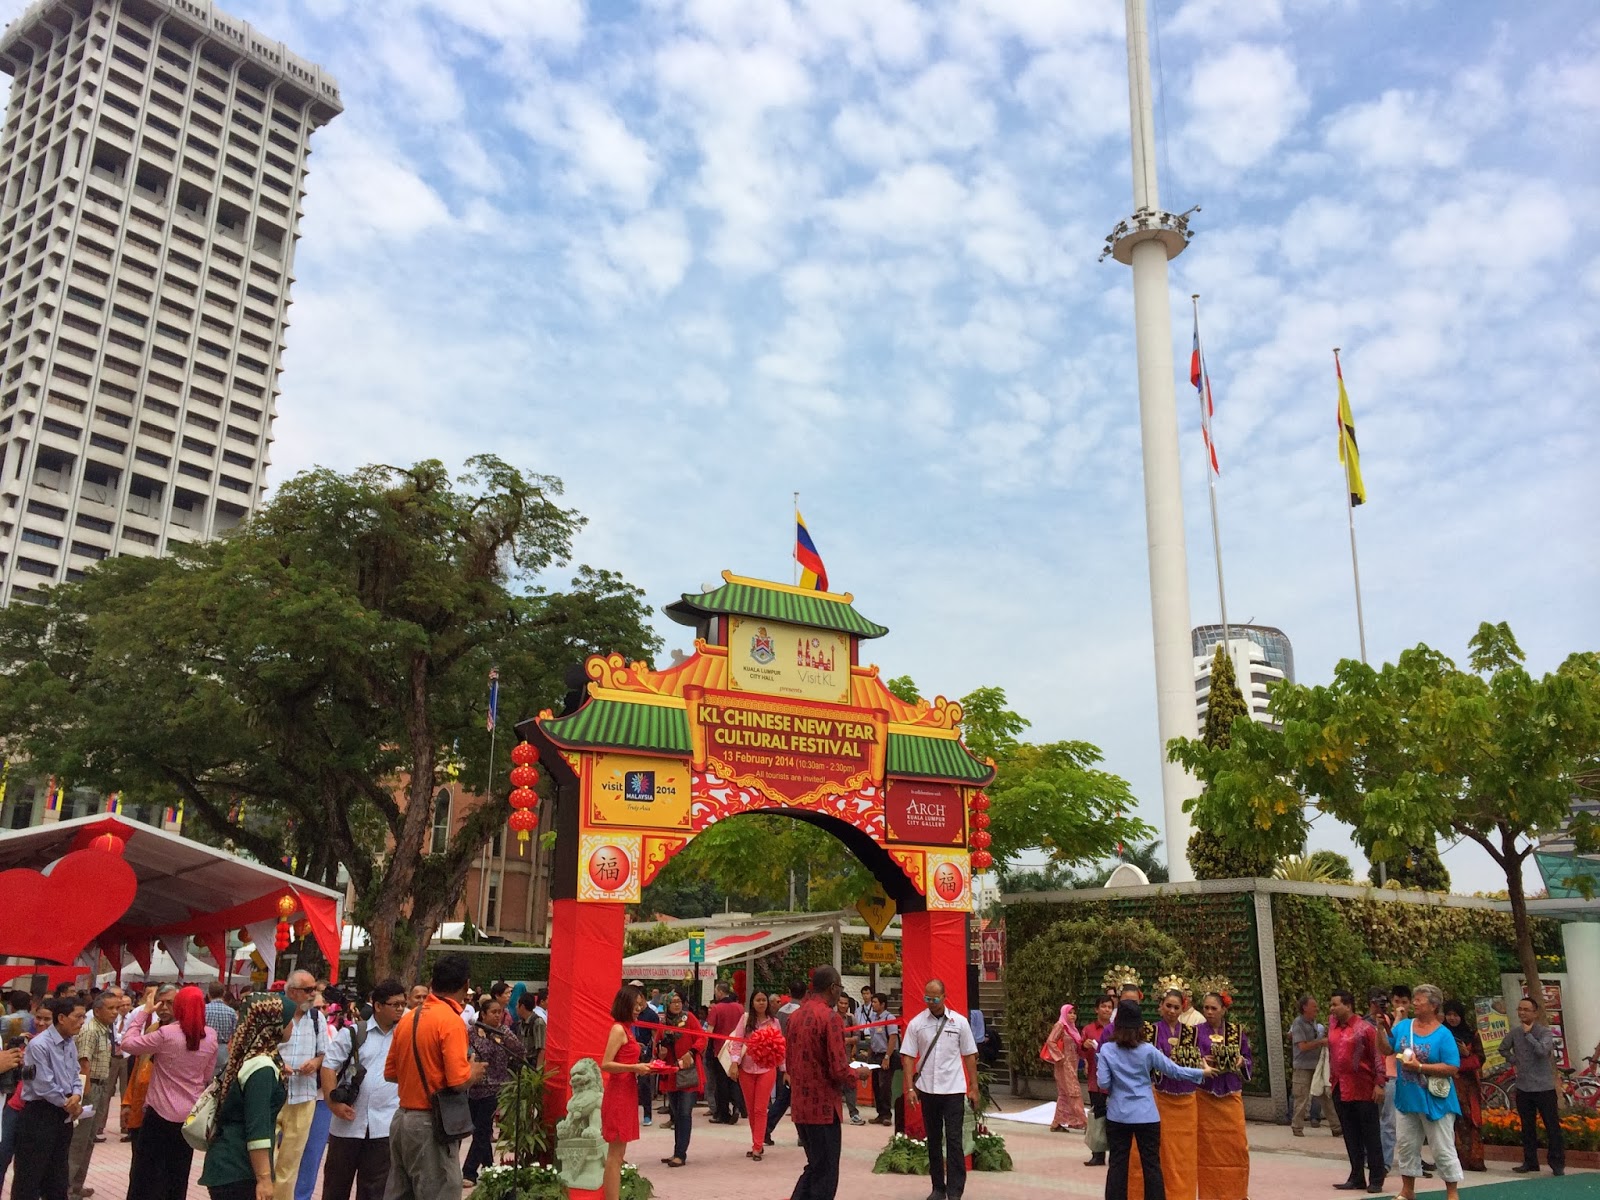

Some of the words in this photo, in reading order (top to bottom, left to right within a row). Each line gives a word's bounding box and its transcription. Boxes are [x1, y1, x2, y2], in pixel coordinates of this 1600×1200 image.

[779, 686, 803, 694] presents
[699, 706, 721, 724] KL
[723, 709, 791, 732] CHINESE
[794, 717, 833, 736] NEW
[834, 721, 874, 741] YEAR
[714, 728, 789, 750] CULTURAL
[791, 737, 861, 758] FESTIVAL
[723, 750, 733, 762] 13
[735, 751, 773, 768] February
[775, 755, 795, 768] 2014
[795, 759, 825, 771] (10:30am
[829, 763, 856, 775] 2:30pm)
[755, 770, 765, 778] All
[765, 771, 790, 781] tourists
[791, 774, 802, 782] are
[802, 773, 826, 783] invited!
[601, 781, 623, 791] visit
[626, 793, 654, 801] MALAYSIA
[656, 786, 676, 795] 2014
[906, 798, 945, 817] ARCH
[595, 856, 620, 881] 福
[938, 871, 956, 893] 福
